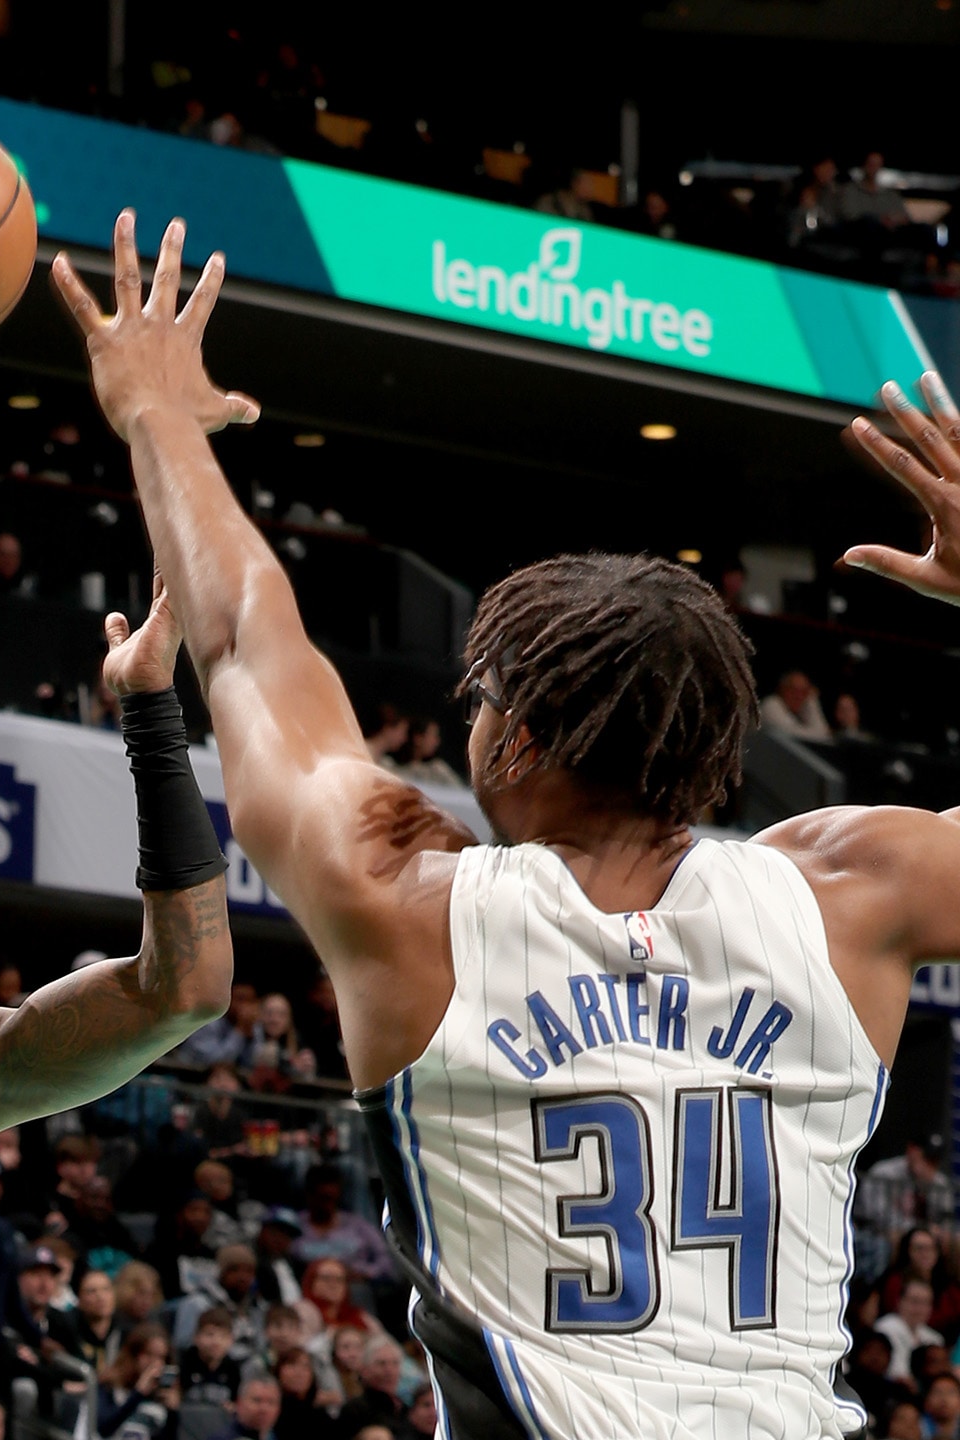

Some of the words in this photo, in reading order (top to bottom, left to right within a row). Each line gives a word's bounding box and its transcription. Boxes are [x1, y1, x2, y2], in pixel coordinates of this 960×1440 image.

[431, 238, 713, 357] lendingtree
[487, 972, 690, 1080] CARTER
[707, 986, 794, 1080] JR.
[530, 1085, 782, 1334] 34
